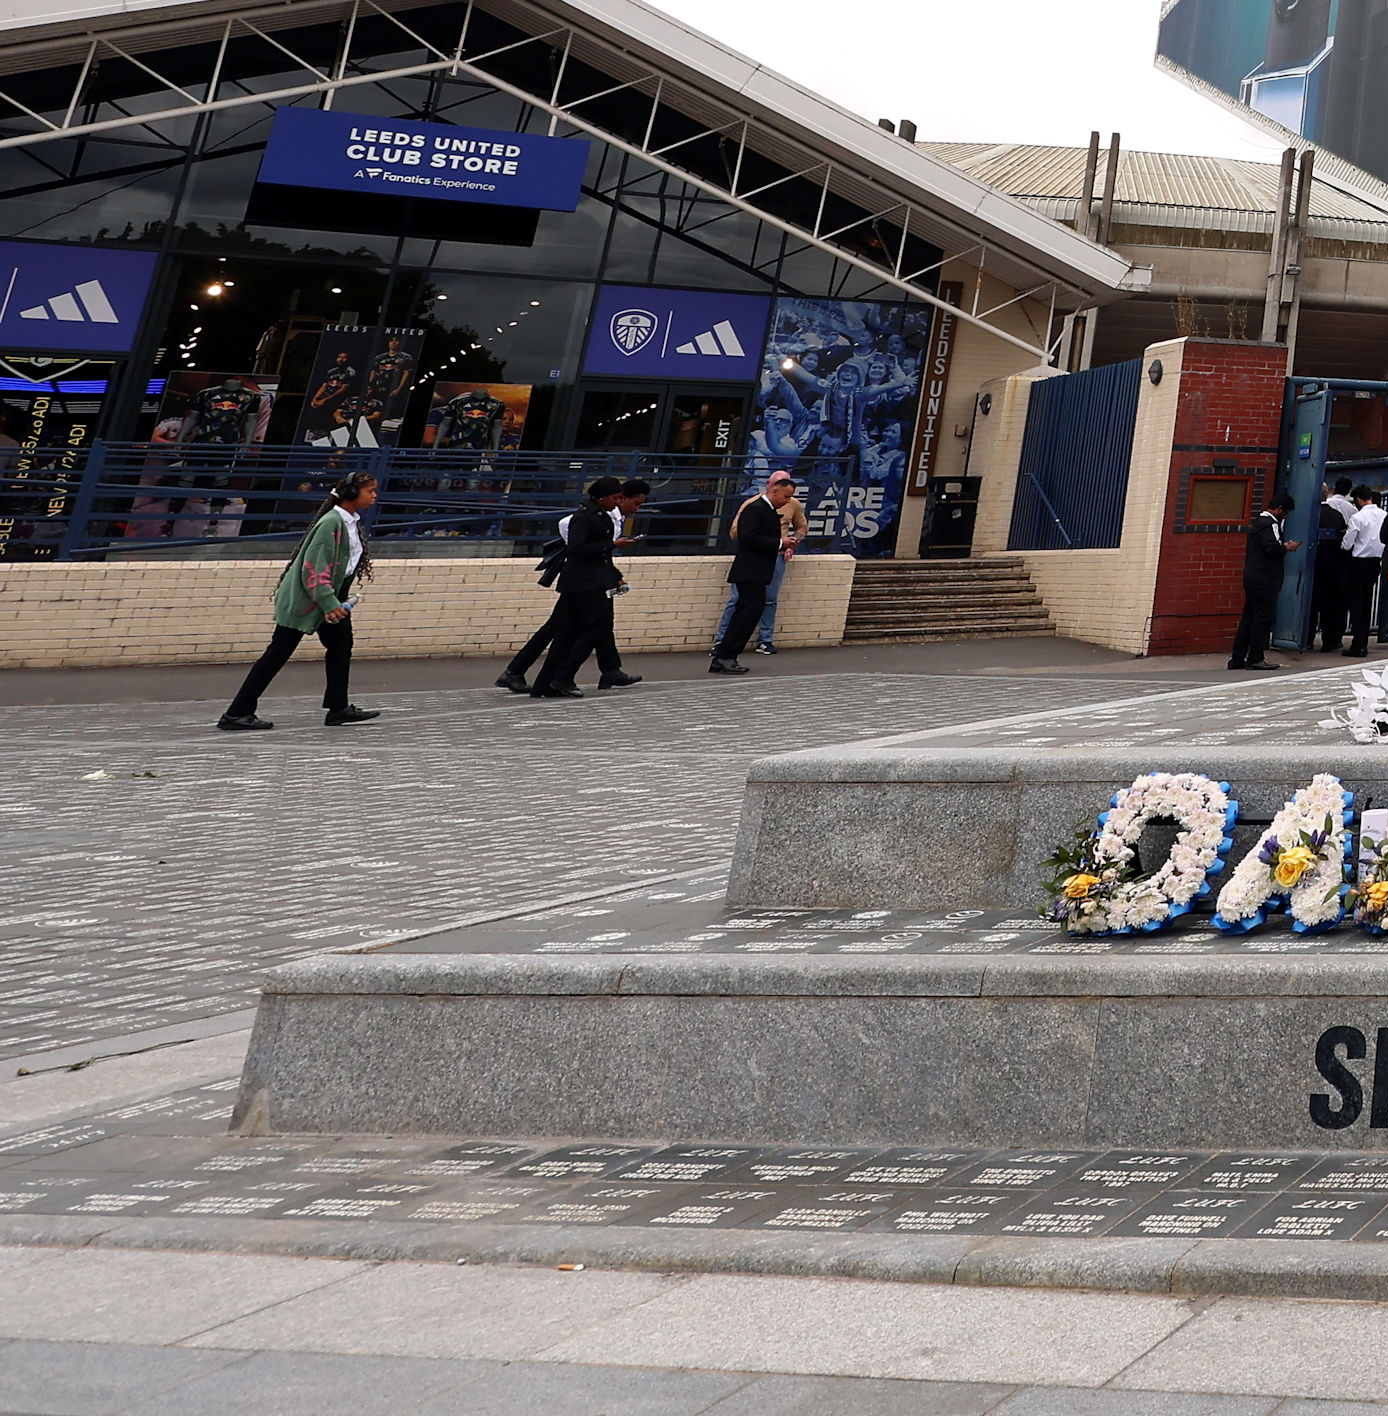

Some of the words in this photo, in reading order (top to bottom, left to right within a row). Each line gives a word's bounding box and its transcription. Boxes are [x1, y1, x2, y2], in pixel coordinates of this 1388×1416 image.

[350, 127, 426, 148] LEEDS
[434, 136, 521, 158] UNITED
[346, 144, 421, 166] CLUB
[430, 153, 519, 175] STORE
[382, 172, 431, 186] Fanatics
[433, 177, 496, 192] Experience
[326, 324, 369, 334] LEEDS
[384, 327, 425, 336] NITED
[715, 419, 731, 448] EXIT
[915, 380, 943, 488] UNITED
